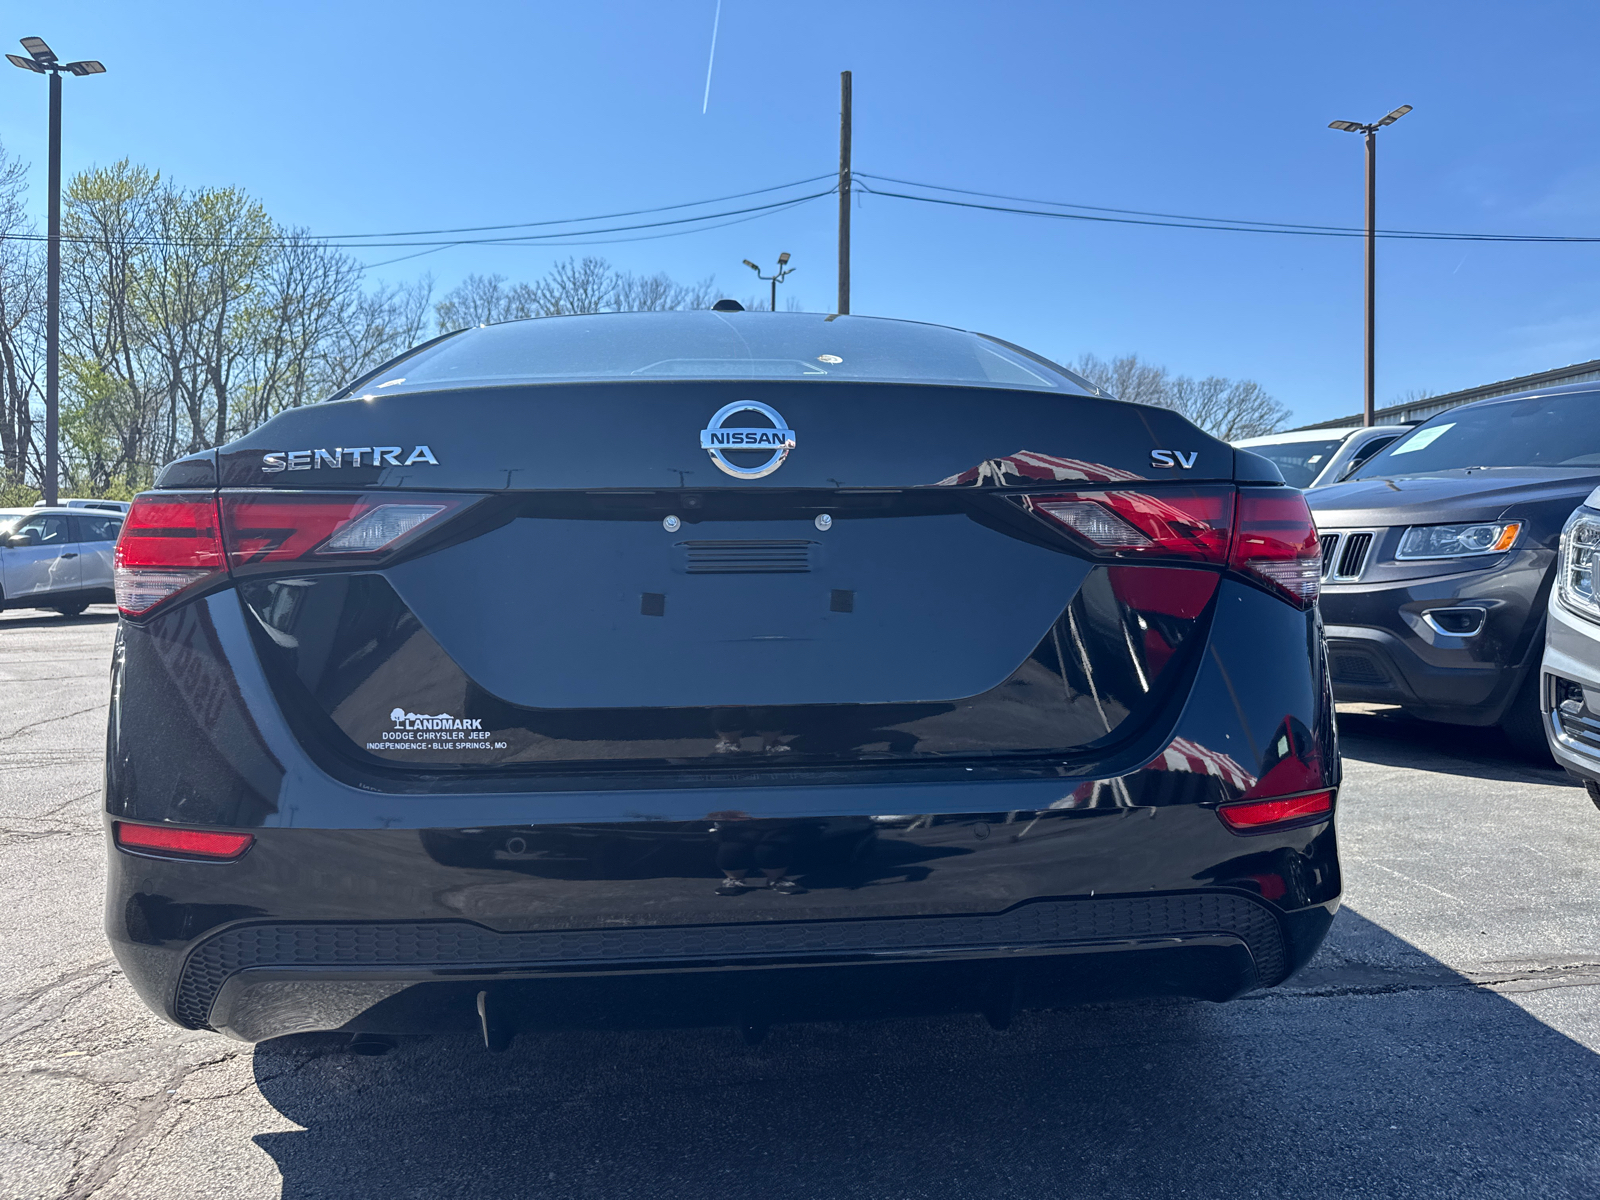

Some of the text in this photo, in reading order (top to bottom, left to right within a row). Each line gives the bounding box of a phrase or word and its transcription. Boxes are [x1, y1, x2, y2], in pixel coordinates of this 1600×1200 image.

[711, 432, 786, 445] NISSAN
[262, 445, 440, 473] SENTRA
[1151, 449, 1198, 469] SV
[405, 718, 482, 730] LANDMARK
[382, 731, 491, 740] DODGE CHRYSLER JEEP
[366, 742, 427, 750] INDEPENDENCE
[455, 742, 494, 750] SPRINGS,
